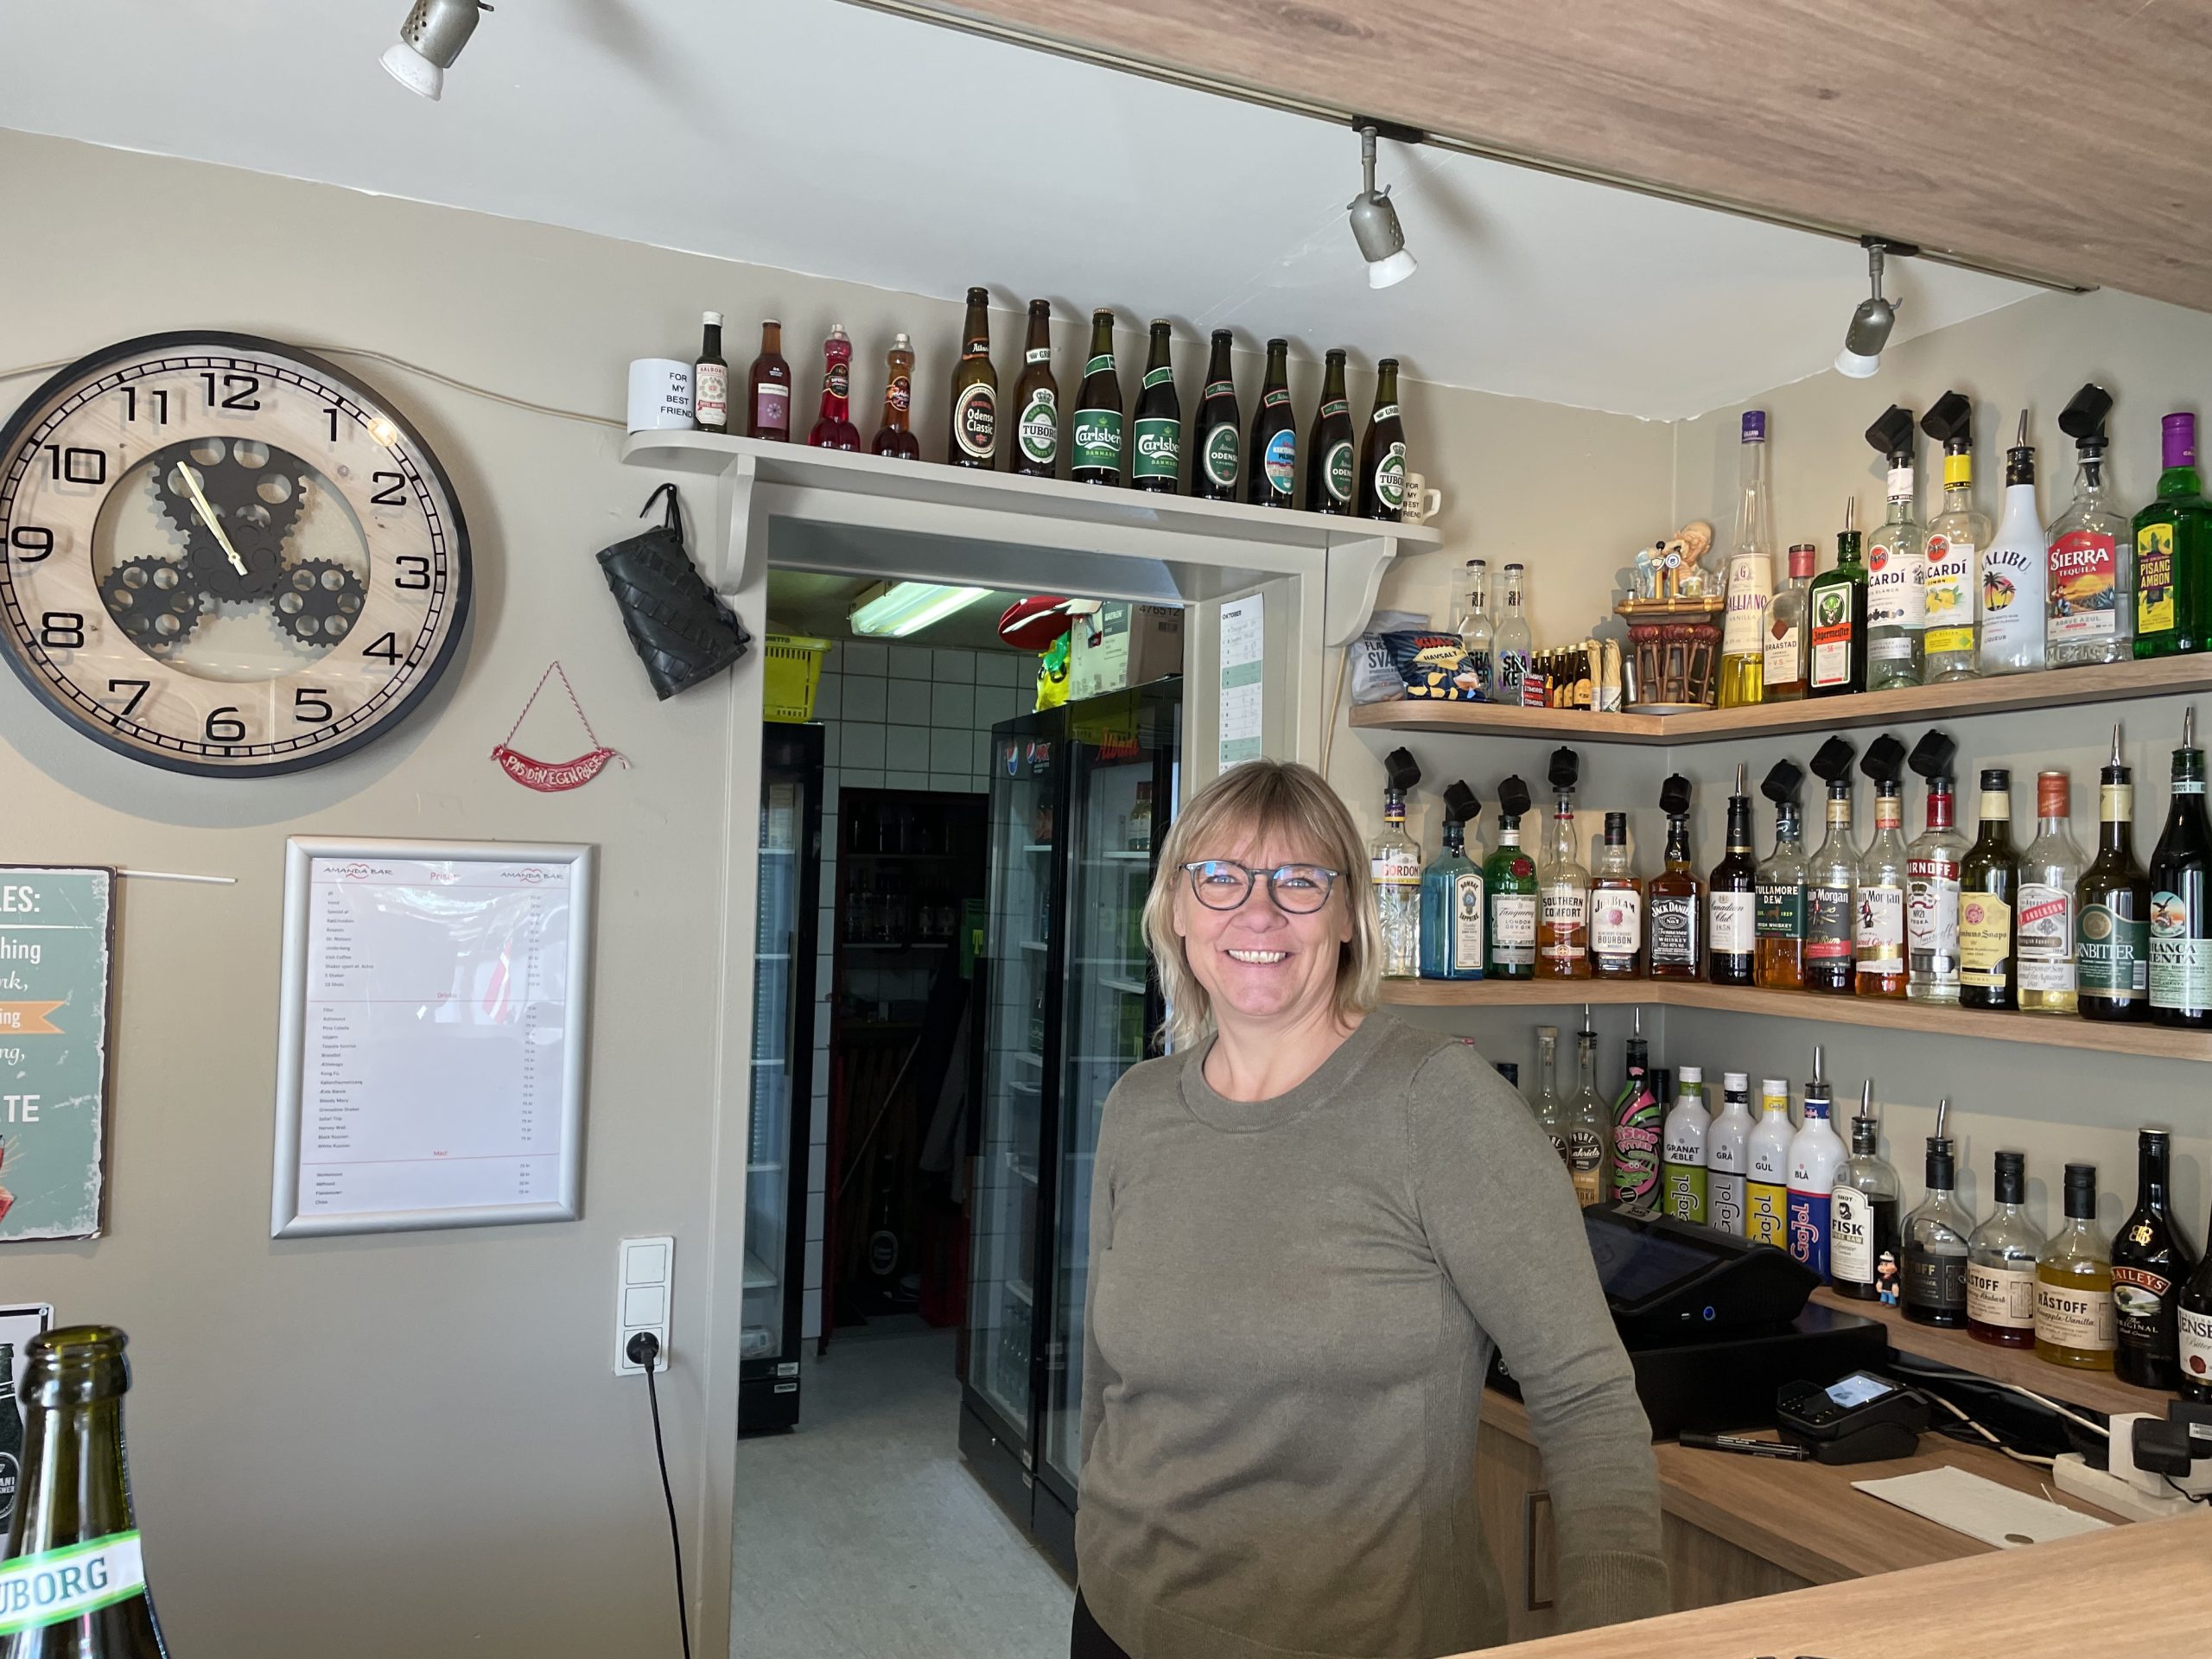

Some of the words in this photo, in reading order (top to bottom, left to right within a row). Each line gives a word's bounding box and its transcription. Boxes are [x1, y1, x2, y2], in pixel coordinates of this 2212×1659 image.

[669, 372, 688, 383] FOR
[200, 372, 260, 410] 12
[671, 384, 685, 393] MY
[121, 386, 168, 424] 11
[666, 395, 690, 405] BEST
[967, 408, 994, 423] Odense
[323, 408, 338, 442] 1
[966, 419, 994, 435] Classic
[44, 444, 106, 485] 10
[372, 471, 407, 505] 2
[11, 526, 54, 562] 9
[2050, 548, 2109, 571] SIERRA
[395, 556, 430, 590] 3
[2059, 566, 2096, 577] TEQUILA
[2140, 559, 2170, 576] PISANG
[1868, 569, 1905, 588] CARDÍ
[2141, 572, 2170, 588] AMBON
[1222, 610, 1242, 620] OKTOBER
[2056, 617, 2077, 626] AGAVE
[41, 613, 84, 649] 8
[362, 632, 404, 665] 4
[1764, 640, 1797, 652] BRAASTAD
[1423, 651, 1458, 661] HAVSALT
[108, 679, 150, 715] 7
[295, 689, 333, 721] 5
[206, 708, 246, 741] 6
[505, 756, 525, 776] PAS
[549, 766, 578, 785] EGEN
[499, 871, 541, 880] AMANDA
[1382, 864, 1421, 877] GORDON
[1909, 861, 1950, 876] IRNOFF
[1459, 880, 1479, 892] BOMBAY
[1755, 885, 1798, 895] TULLAMORE
[0, 886, 41, 913] ES:
[1542, 896, 1584, 907] SOUTHERN
[1764, 895, 1783, 905] D.E.W.
[1817, 888, 1849, 904] Morgan
[1612, 896, 1635, 913] BEAM
[1651, 904, 1669, 918] JACK
[2025, 902, 2064, 921] ANDERSON
[1459, 912, 1479, 922] SAPPHIRE
[1498, 907, 1534, 918] Tanqueray
[1545, 907, 1581, 918] COMFORT
[1714, 911, 1734, 923] Club
[1598, 936, 1632, 944] BOURBON
[2076, 943, 2134, 960] RNBITTER
[2152, 943, 2196, 954] RANCA
[1573, 1131, 1595, 1143] PURE
[1666, 1144, 1700, 1154] GRANAT
[1716, 1149, 1732, 1161] GRÅ
[1670, 1152, 1694, 1162] ÆBLE
[1755, 1162, 1773, 1172] GUL
[1795, 1169, 1808, 1180] BLÅ
[1832, 1218, 1863, 1236] FISK
[1968, 1274, 1999, 1292] STOFF
[2037, 1291, 2088, 1314] RÅSTOFF
